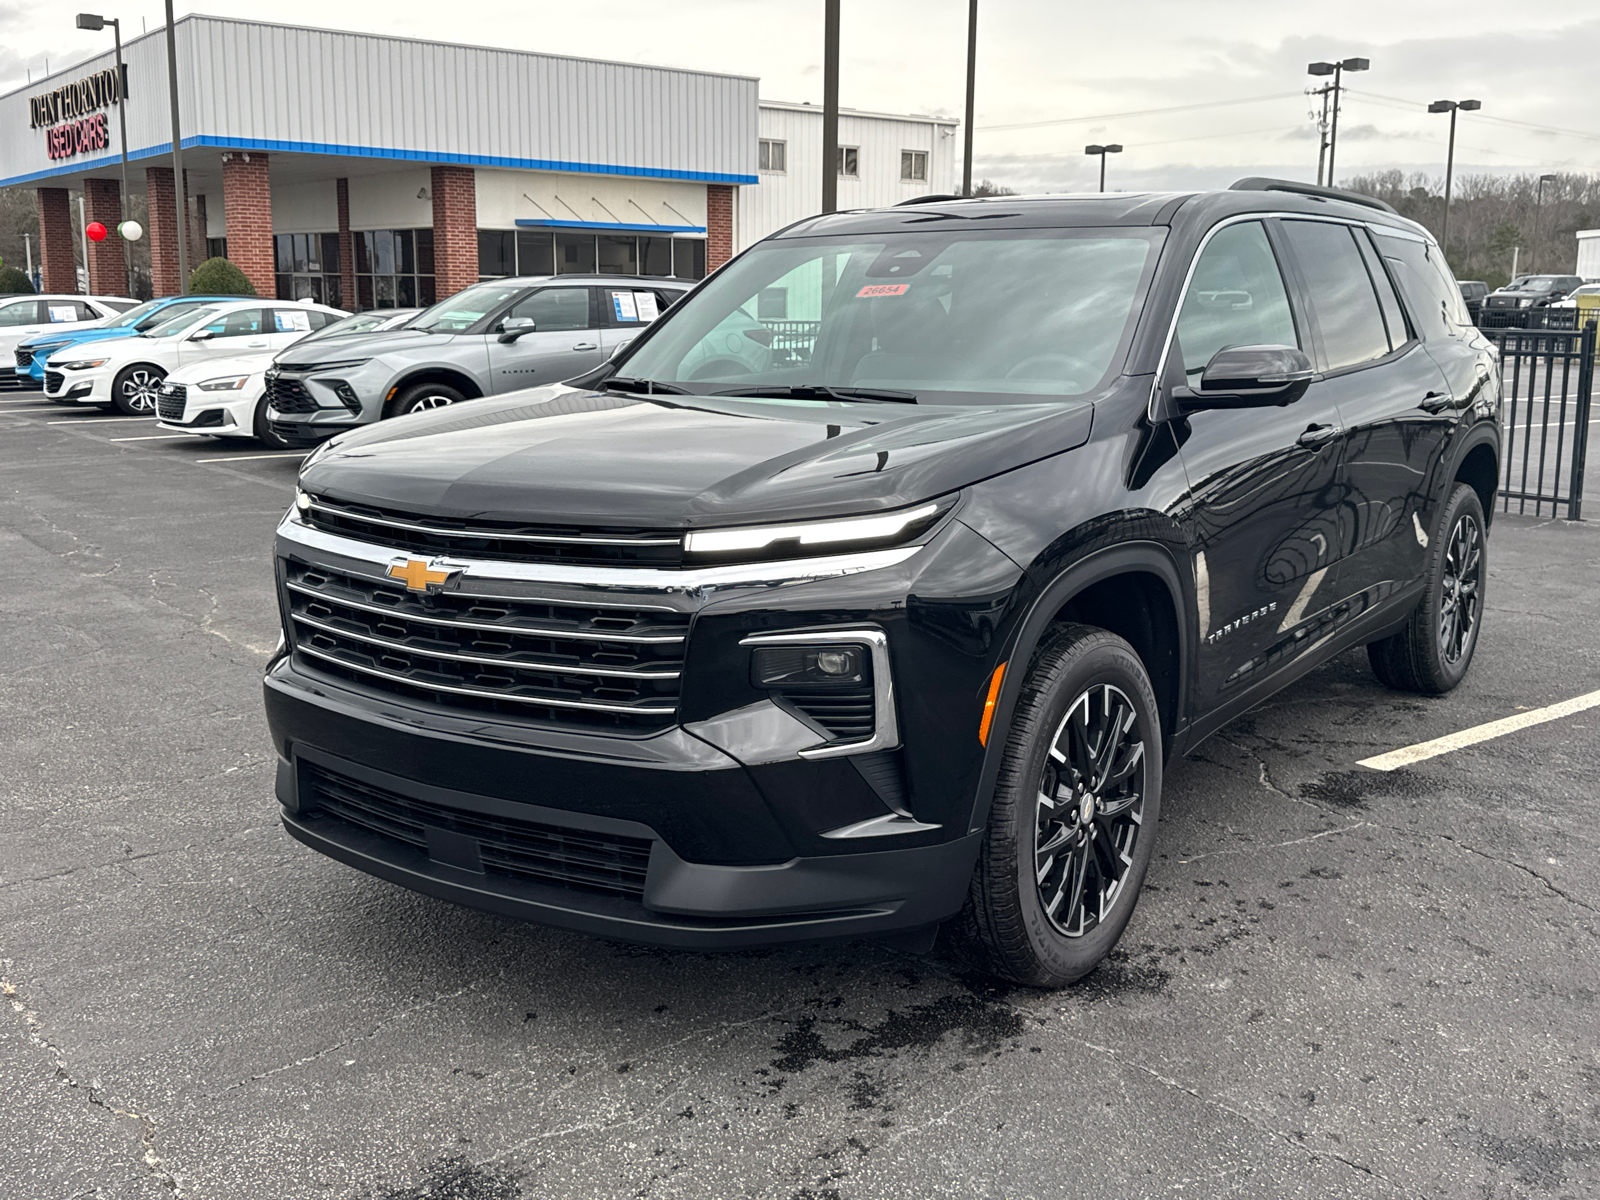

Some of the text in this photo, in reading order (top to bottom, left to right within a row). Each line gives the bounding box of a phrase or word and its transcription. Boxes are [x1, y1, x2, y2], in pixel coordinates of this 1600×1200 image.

[29, 63, 129, 129] JOHN THORNTON
[46, 113, 109, 160] USED CARS
[863, 285, 901, 295] 26654
[1208, 601, 1277, 645] TRAVERSE
